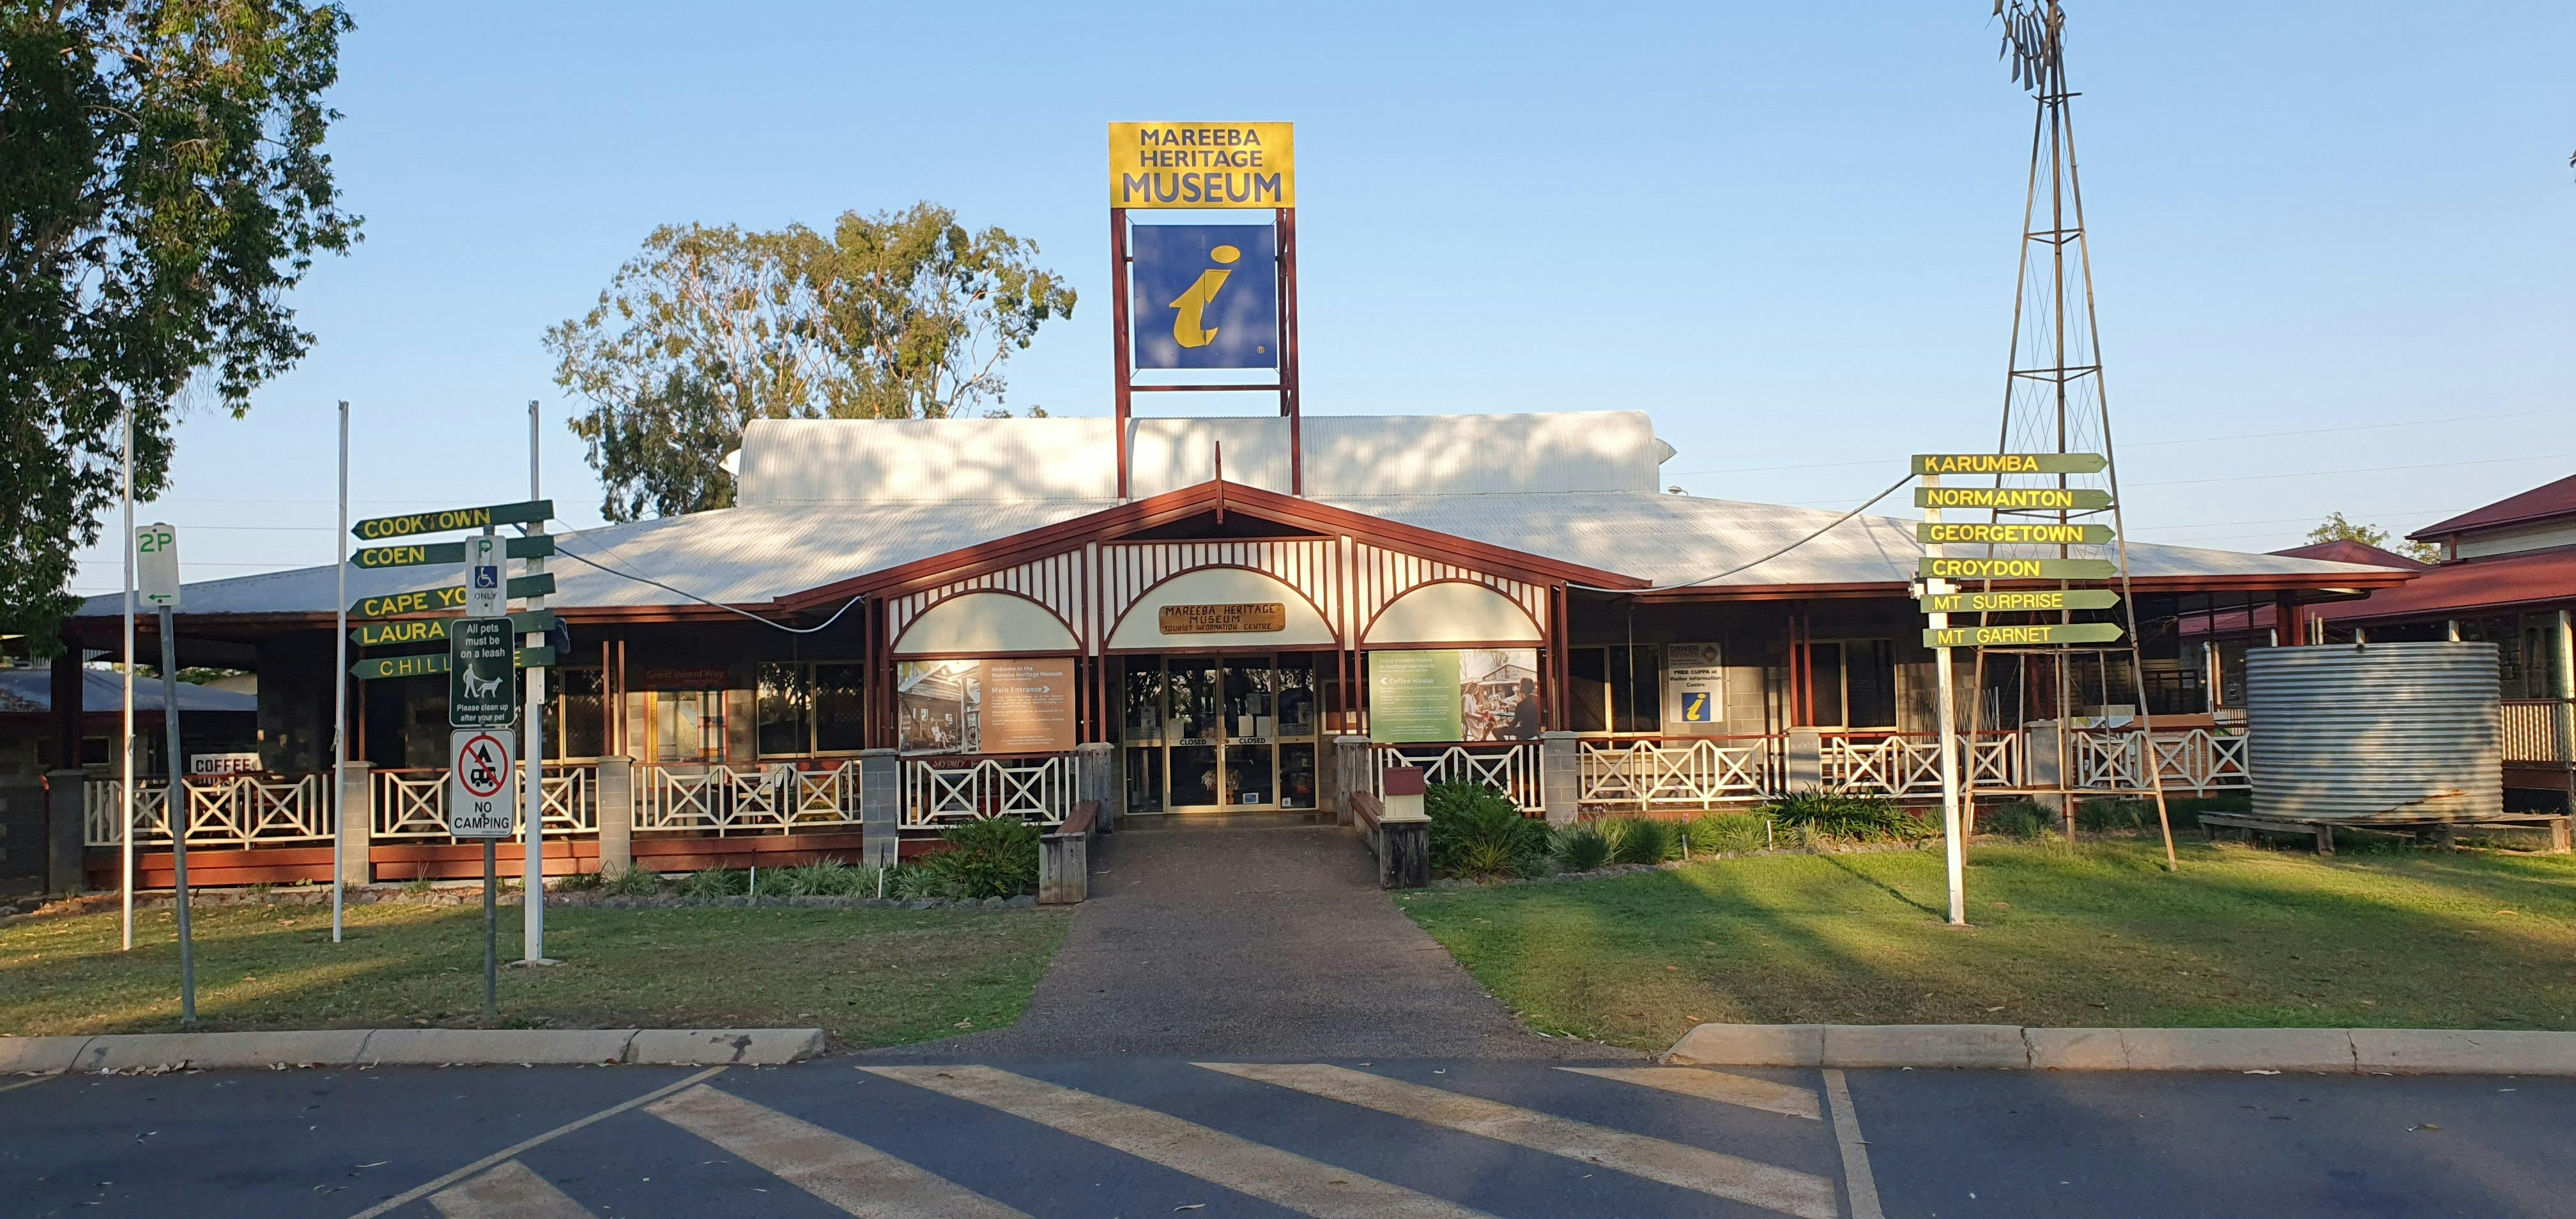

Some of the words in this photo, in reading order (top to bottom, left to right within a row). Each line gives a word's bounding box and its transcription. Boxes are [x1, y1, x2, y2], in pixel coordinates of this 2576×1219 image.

[1141, 129, 1261, 146] MAREEBA
[1140, 150, 1262, 167] HERITAGE
[1123, 172, 1281, 203] MUSEUM
[1925, 456, 2039, 472] KARUMBA
[1928, 489, 2072, 507] NORMANTON
[364, 509, 491, 538] COOKTOWN
[1930, 525, 2083, 542] GEORGETOWN
[139, 533, 172, 552] 2P
[479, 540, 493, 558] P
[363, 546, 425, 565] COEN
[1933, 560, 2040, 576] CROYDON
[365, 592, 428, 617] CAPE
[1165, 606, 1216, 616] MAREEBA
[1224, 604, 1275, 614] HERITAGE
[1935, 595, 1962, 610] MT
[1973, 593, 2063, 609] SURPRISE
[1165, 624, 1192, 632] TOURIST
[1190, 615, 1240, 624] MUSEUM
[363, 622, 445, 645] LAURA
[467, 624, 478, 633] All
[480, 624, 498, 635] pets
[1938, 629, 1965, 644] MT
[1977, 627, 2052, 643] GARNET
[489, 636, 500, 645] be
[482, 648, 505, 657] leash
[379, 651, 521, 675] CHILLE
[196, 759, 250, 772] COFFEE
[475, 801, 491, 813] NO
[454, 817, 509, 829] CAMPING
